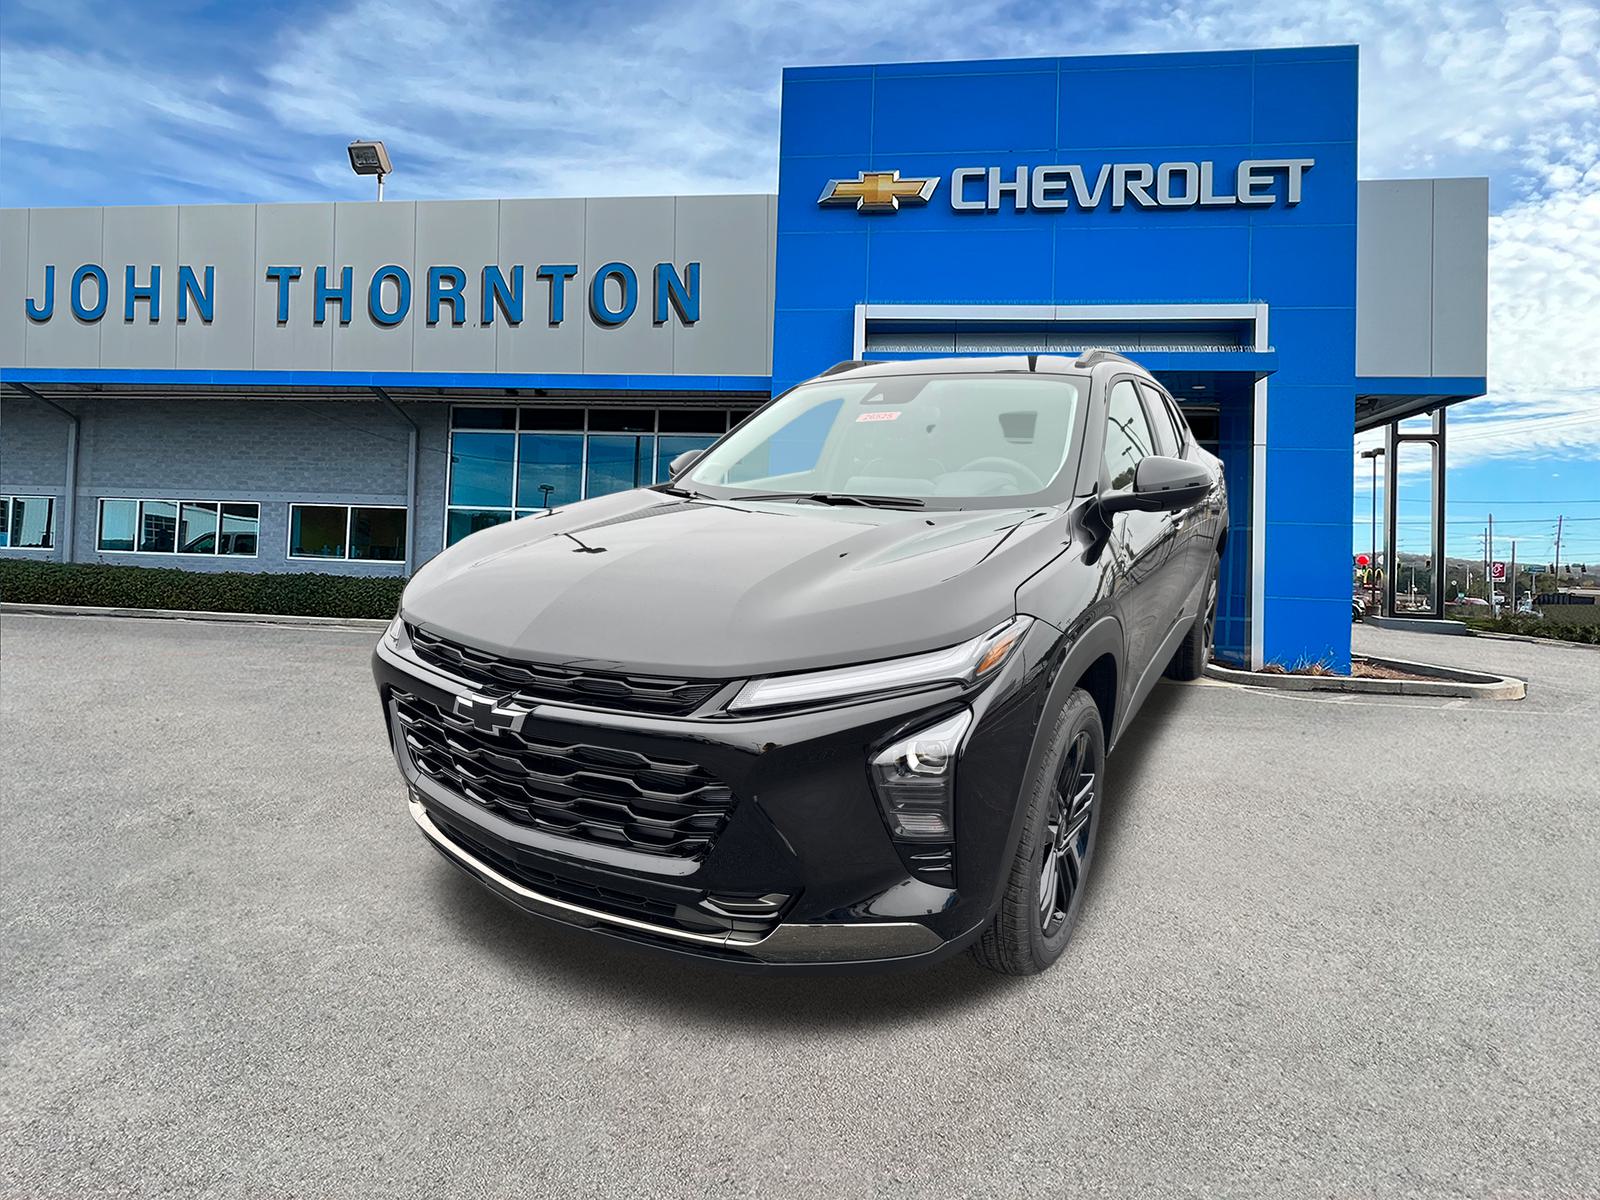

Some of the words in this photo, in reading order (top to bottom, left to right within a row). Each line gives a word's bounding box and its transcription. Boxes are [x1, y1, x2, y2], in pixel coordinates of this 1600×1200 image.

[951, 159, 1315, 211] CHEVROLET
[26, 264, 215, 323] JOHN
[267, 262, 702, 327] THORNTON
